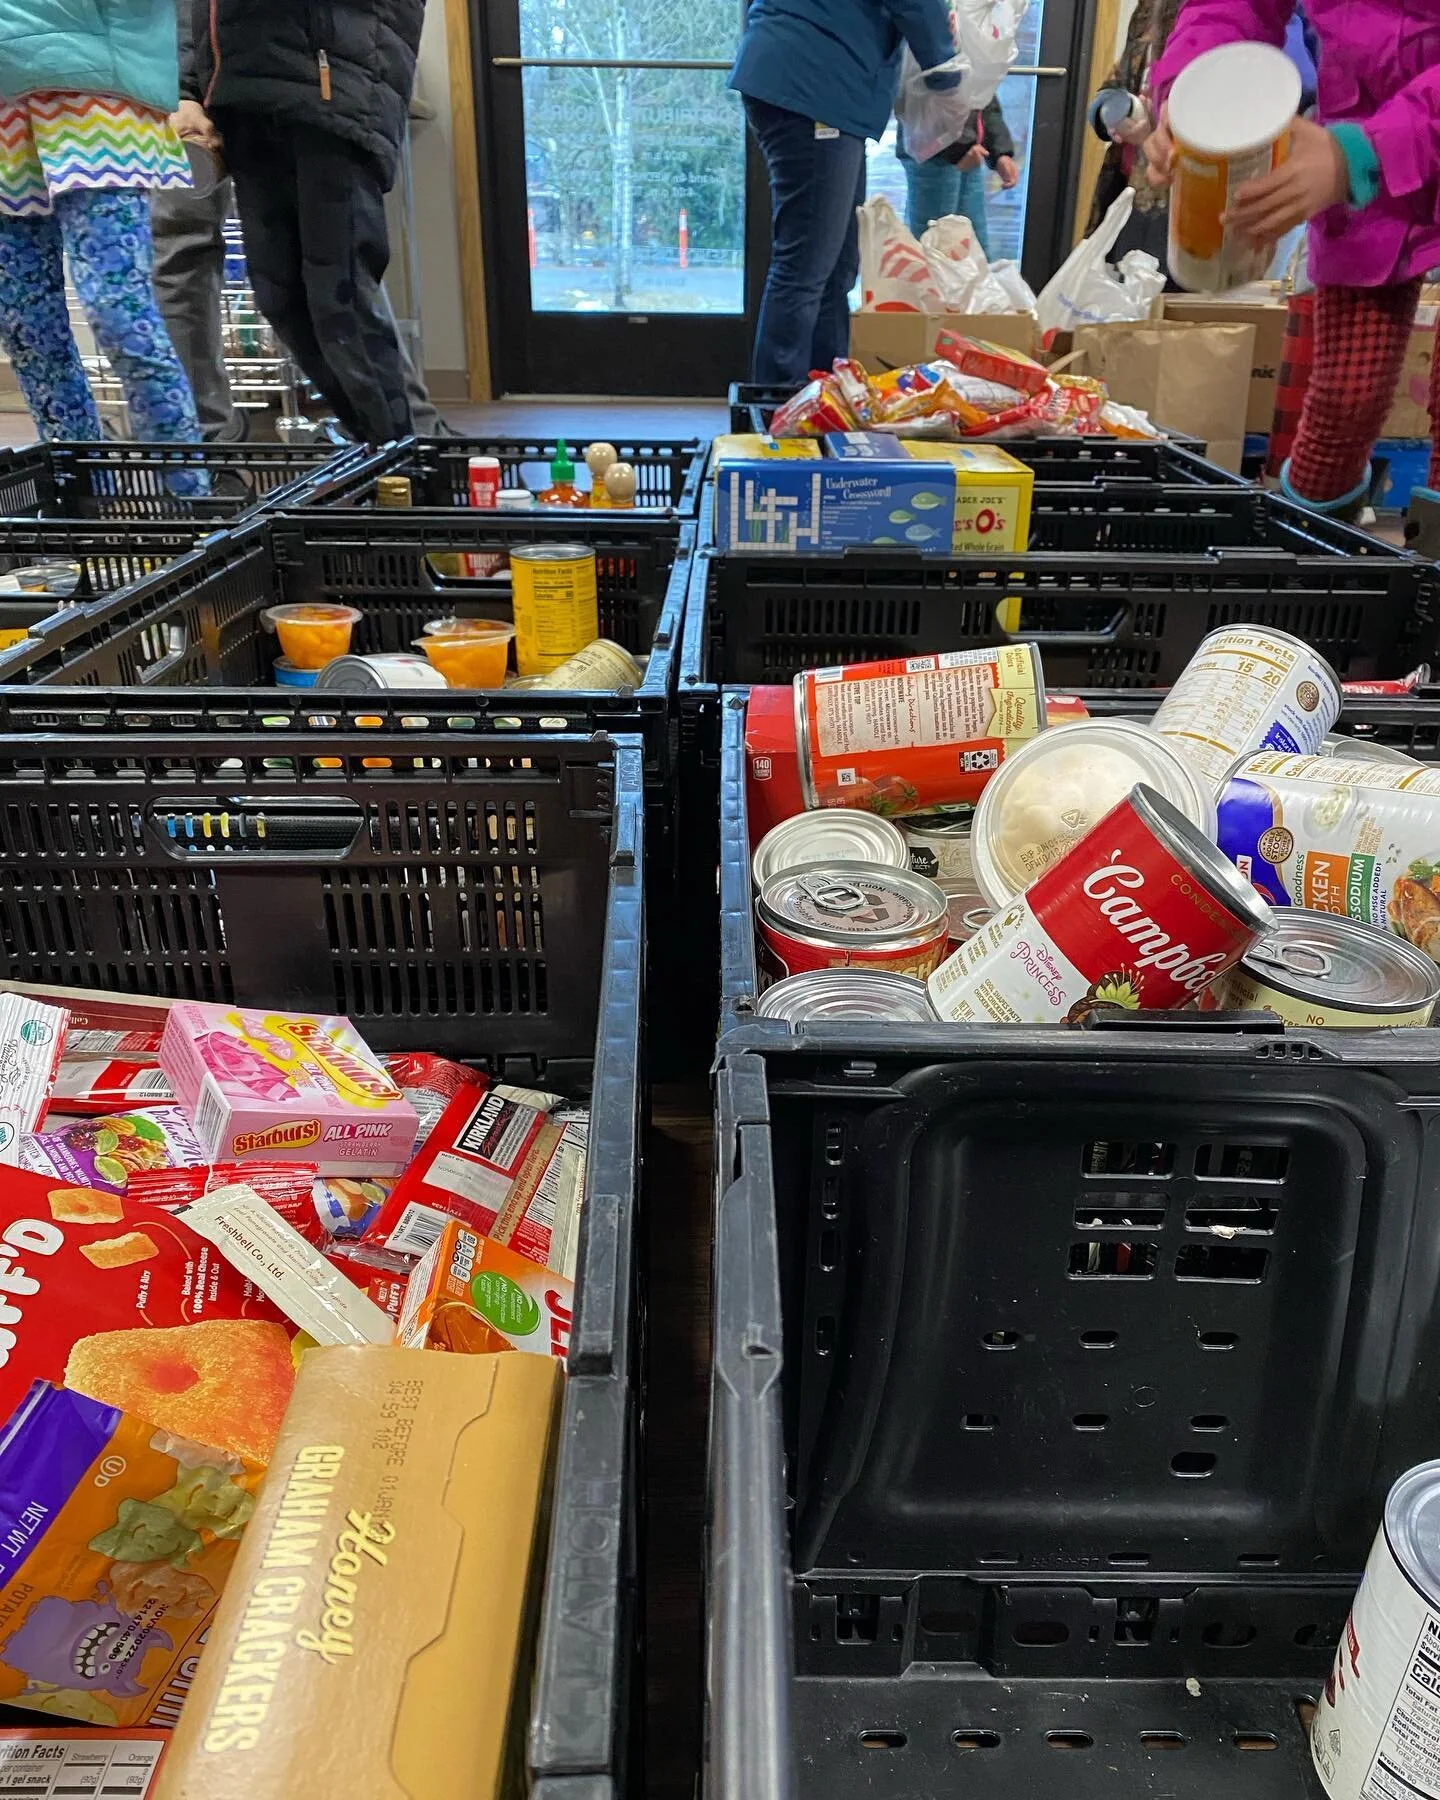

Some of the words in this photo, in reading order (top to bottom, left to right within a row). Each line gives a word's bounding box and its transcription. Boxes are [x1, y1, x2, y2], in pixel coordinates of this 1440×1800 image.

[1251, 365, 1276, 378] nic
[1257, 640, 1296, 662] Facts
[1238, 661, 1253, 674] 15
[1262, 670, 1282, 684] 20
[906, 698, 917, 733] Directions
[755, 759, 769, 769] 140
[1265, 832, 1275, 853] DOUBLE
[1271, 830, 1282, 860] STOCK
[910, 852, 928, 864] ture
[1312, 860, 1331, 913] CKEN
[1350, 858, 1365, 910] SODIUM
[1331, 885, 1341, 914] OTH
[1083, 849, 1228, 992] Campbe
[1009, 941, 1067, 1007] PRINCESS
[986, 994, 1006, 1017] CHICKEN
[991, 988, 1010, 1010] SHAPES
[69, 1015, 88, 1025] Coll
[1306, 1014, 1324, 1025] NO
[323, 1124, 352, 1143] ALL
[353, 1123, 393, 1137] PINK
[463, 1096, 505, 1150] KIRKLAND
[339, 1148, 378, 1157] GELATIN
[213, 1213, 254, 1251] Freshbell
[248, 1246, 270, 1267] Co.,
[265, 1261, 286, 1281] Ltd.
[184, 1260, 193, 1274] with
[198, 1246, 208, 1273] Cheese
[211, 1262, 219, 1275] Out
[140, 1268, 150, 1284] Airy
[182, 1274, 192, 1296] Baked
[196, 1272, 205, 1290] Real
[501, 1282, 506, 1292] NO
[136, 1289, 147, 1309] Puffy
[193, 1290, 203, 1314] 100%
[208, 1280, 218, 1301] Inside
[516, 1294, 521, 1304] NO
[400, 1377, 424, 1411] BEST
[385, 1415, 414, 1468] BEFORE
[14, 1500, 48, 1534] NET
[257, 1443, 345, 1570] GRAHAM
[0, 1527, 28, 1557] WT
[296, 1508, 396, 1665] Honey
[1421, 1642, 1440, 1660] Servi
[1424, 1634, 1440, 1650] Abou
[203, 1575, 307, 1753] CRACKERS
[1412, 1664, 1440, 1691] Cal
[1405, 1685, 1424, 1703] Total
[1425, 1699, 1440, 1712] Fat
[1413, 1701, 1440, 1723] Saturat
[1393, 1715, 1422, 1739] Sodium
[1397, 1708, 1440, 1742] Cholesterol
[0, 1743, 30, 1760] rition
[32, 1743, 65, 1759] Facts
[128, 1752, 153, 1762] Orange
[1391, 1723, 1410, 1740] Total
[1411, 1738, 1440, 1762] Carbohy
[1379, 1751, 1407, 1776] Protein
[11, 1774, 25, 1785] gel
[25, 1774, 51, 1784] snack
